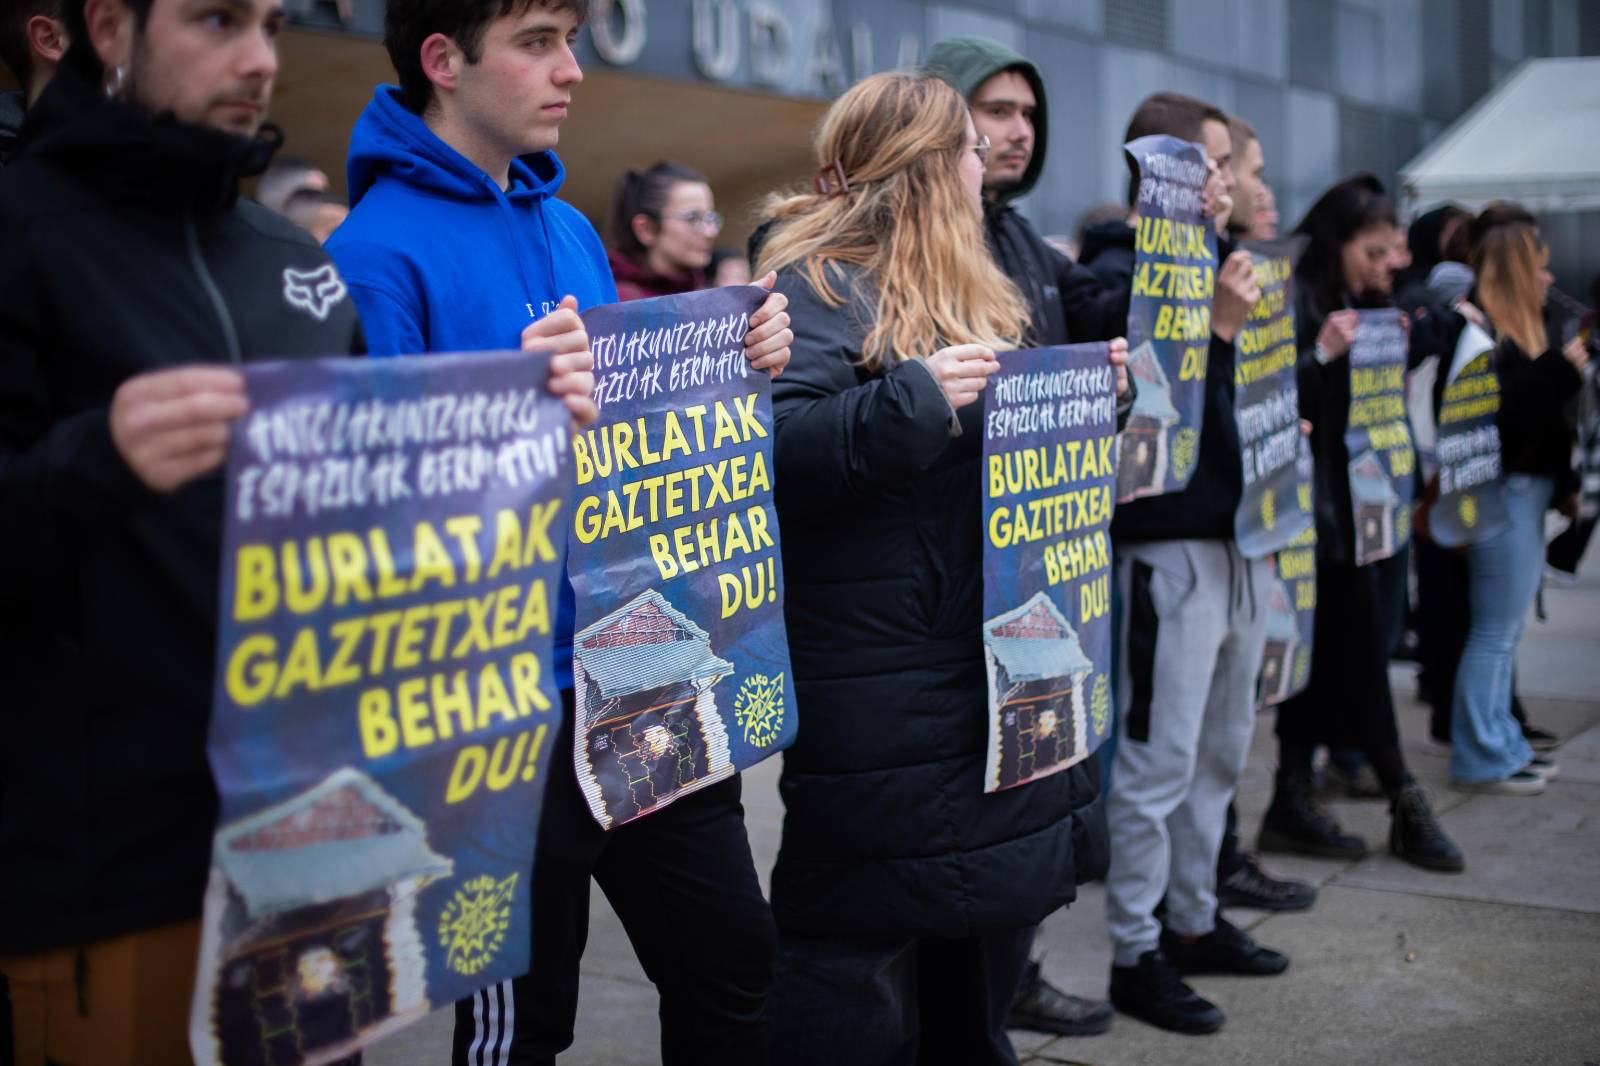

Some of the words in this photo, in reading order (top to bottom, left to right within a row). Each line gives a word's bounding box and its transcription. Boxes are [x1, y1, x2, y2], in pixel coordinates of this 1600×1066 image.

[592, 312, 749, 370] TOLAKUNTZARAKO
[572, 393, 768, 486] BURLATAK
[989, 436, 1115, 498] BURLATAK
[574, 451, 771, 545] GAZTETXEA
[988, 485, 1112, 549] GAZTETXEA
[233, 499, 561, 621] BURLATAK
[649, 506, 775, 581] BEHAR
[1044, 530, 1109, 586] BEHAR
[717, 557, 777, 620] DU!
[1080, 575, 1110, 624] DU!
[225, 580, 550, 706] GAZTETXEA
[358, 652, 551, 758] BEHAR
[445, 724, 548, 804] DU!
